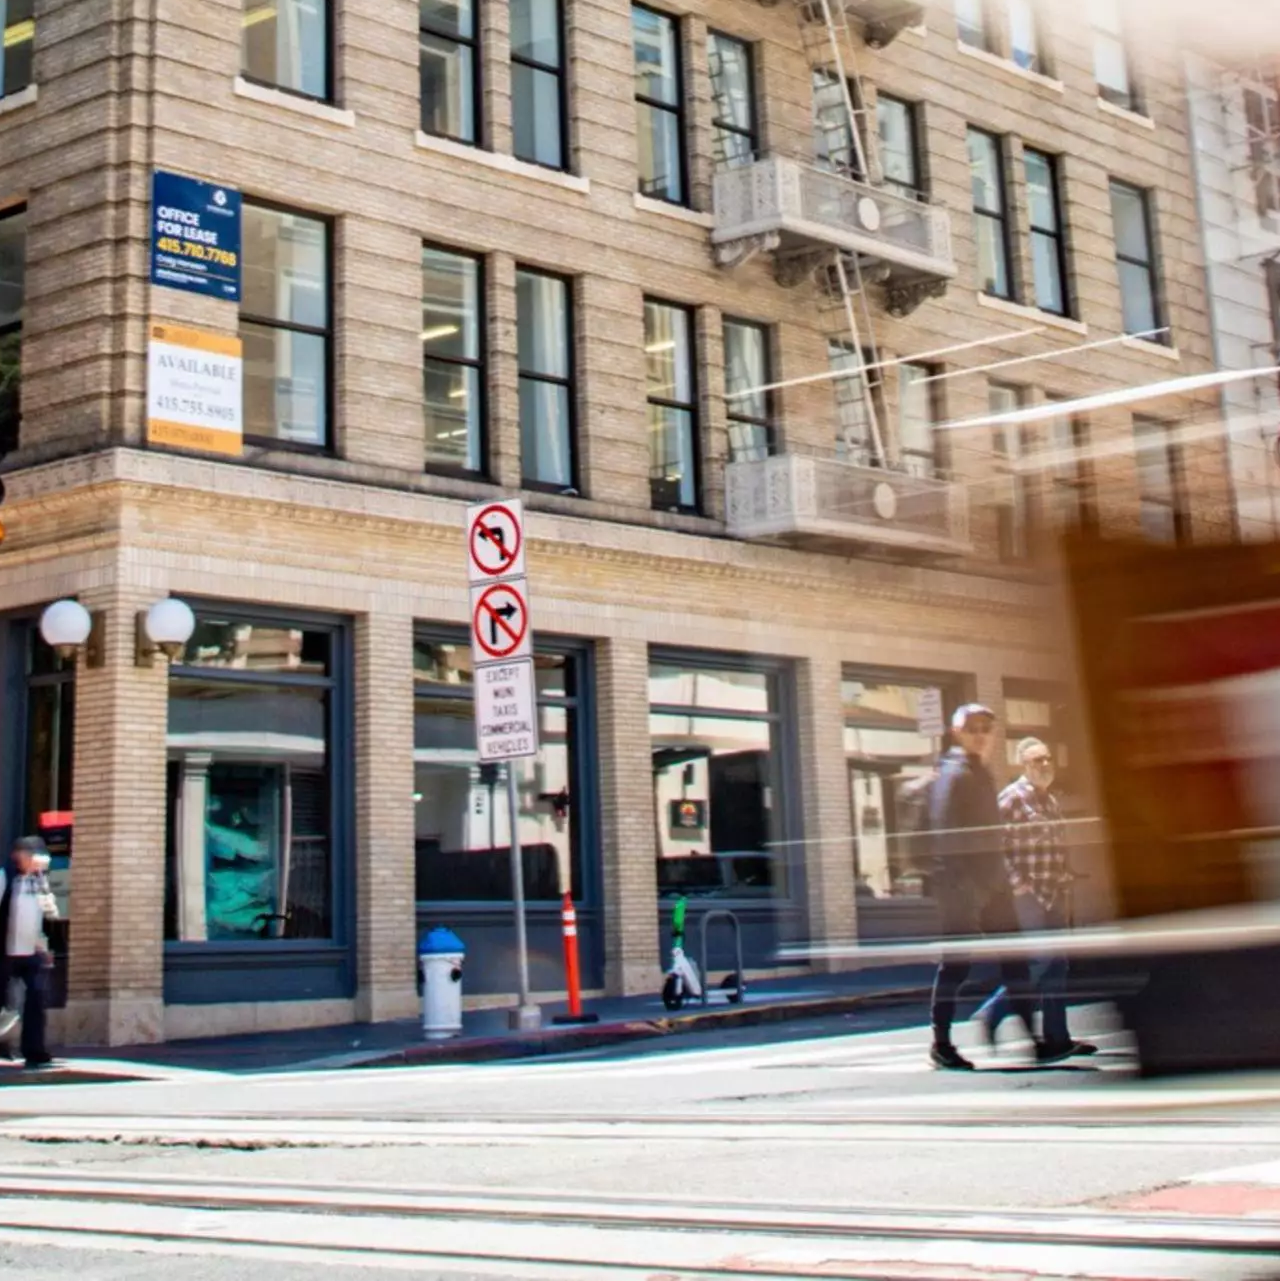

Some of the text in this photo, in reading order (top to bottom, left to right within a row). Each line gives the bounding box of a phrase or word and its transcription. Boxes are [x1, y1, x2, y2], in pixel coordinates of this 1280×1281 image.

[157, 205, 200, 226] OFFICE
[156, 220, 218, 245] FOR LEASE
[157, 354, 237, 380] AVAILABLE
[486, 666, 520, 683] EXCEPT
[493, 686, 515, 699] MUNI
[493, 703, 518, 717] TAXIS
[482, 721, 531, 735] COMMERCIAL
[487, 738, 528, 753] VEHICLES
